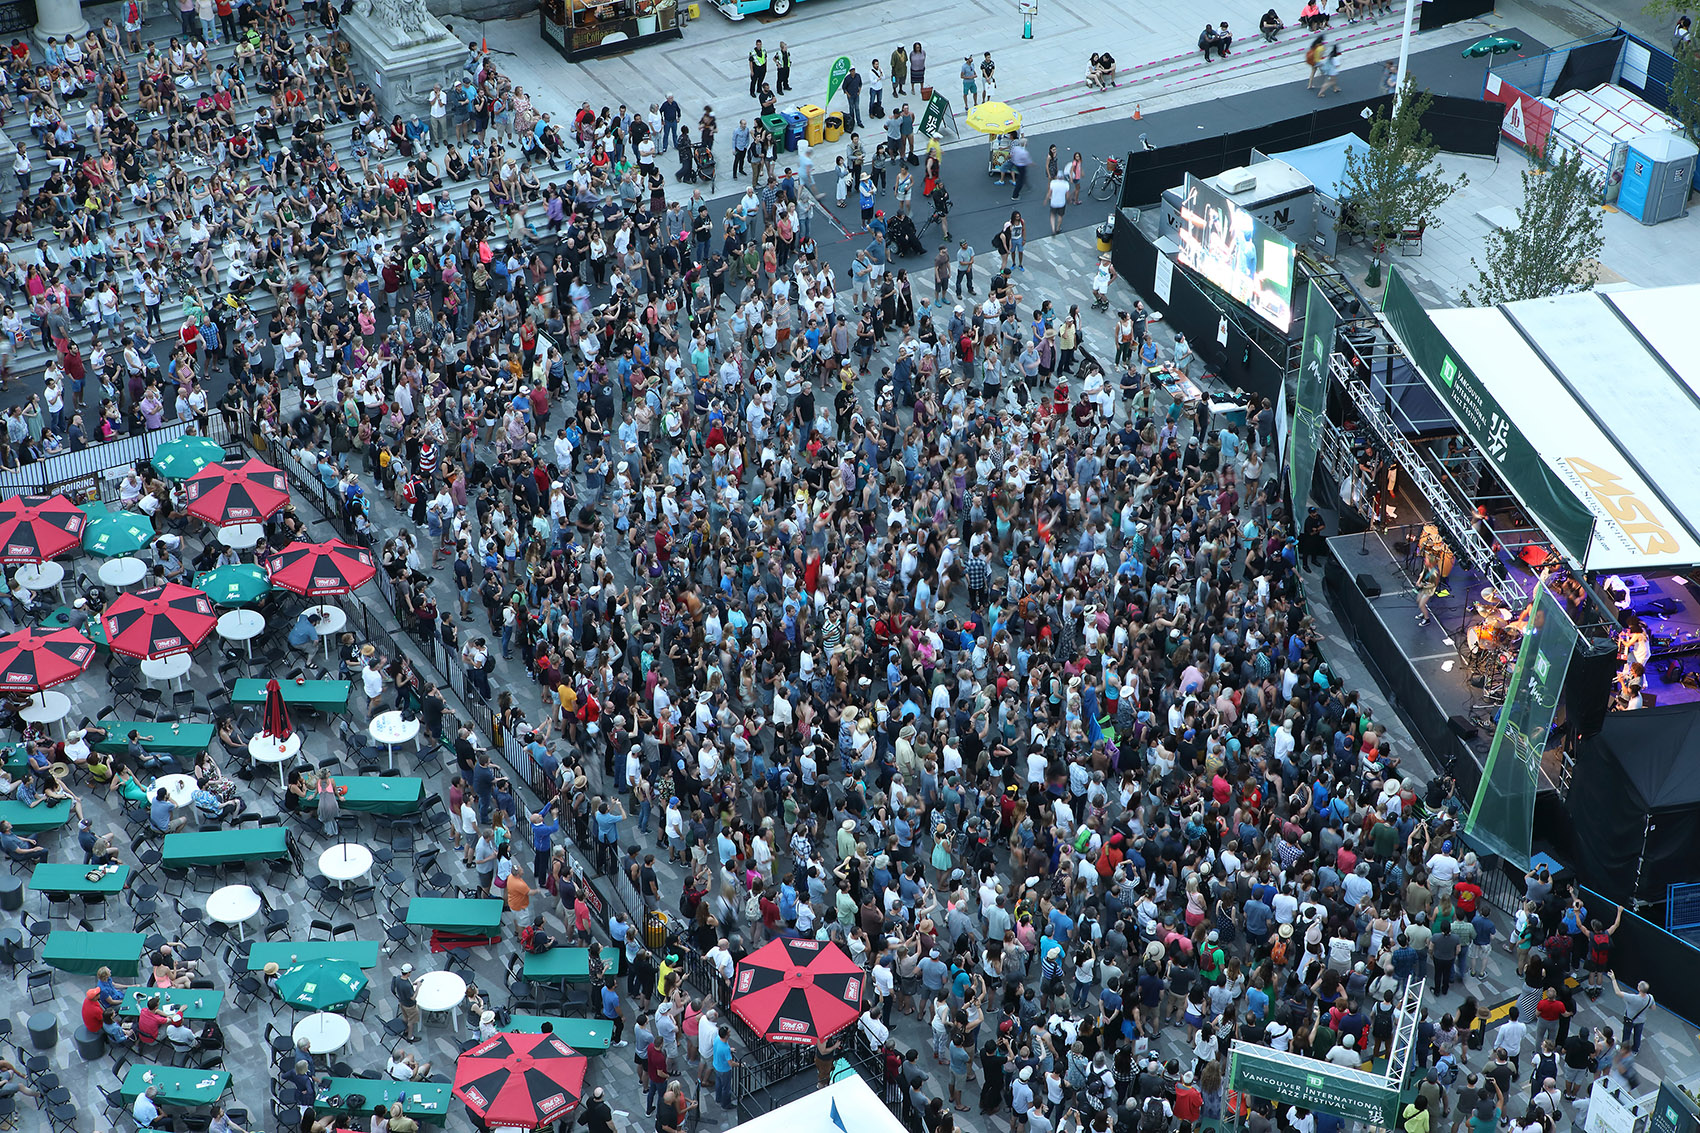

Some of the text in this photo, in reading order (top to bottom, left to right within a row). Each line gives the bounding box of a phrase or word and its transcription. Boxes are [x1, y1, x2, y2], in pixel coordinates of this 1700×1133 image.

[1453, 380, 1487, 426] INTERNATIONAL
[1457, 370, 1484, 407] VANCOUVER
[1450, 390, 1482, 431] JAZZ FESTIVAL
[1564, 457, 1681, 555] MSR
[1242, 1070, 1382, 1112] VANCOUVER INTERNATIONAL
[1276, 1086, 1346, 1110] JAZZ FESTIVAL
